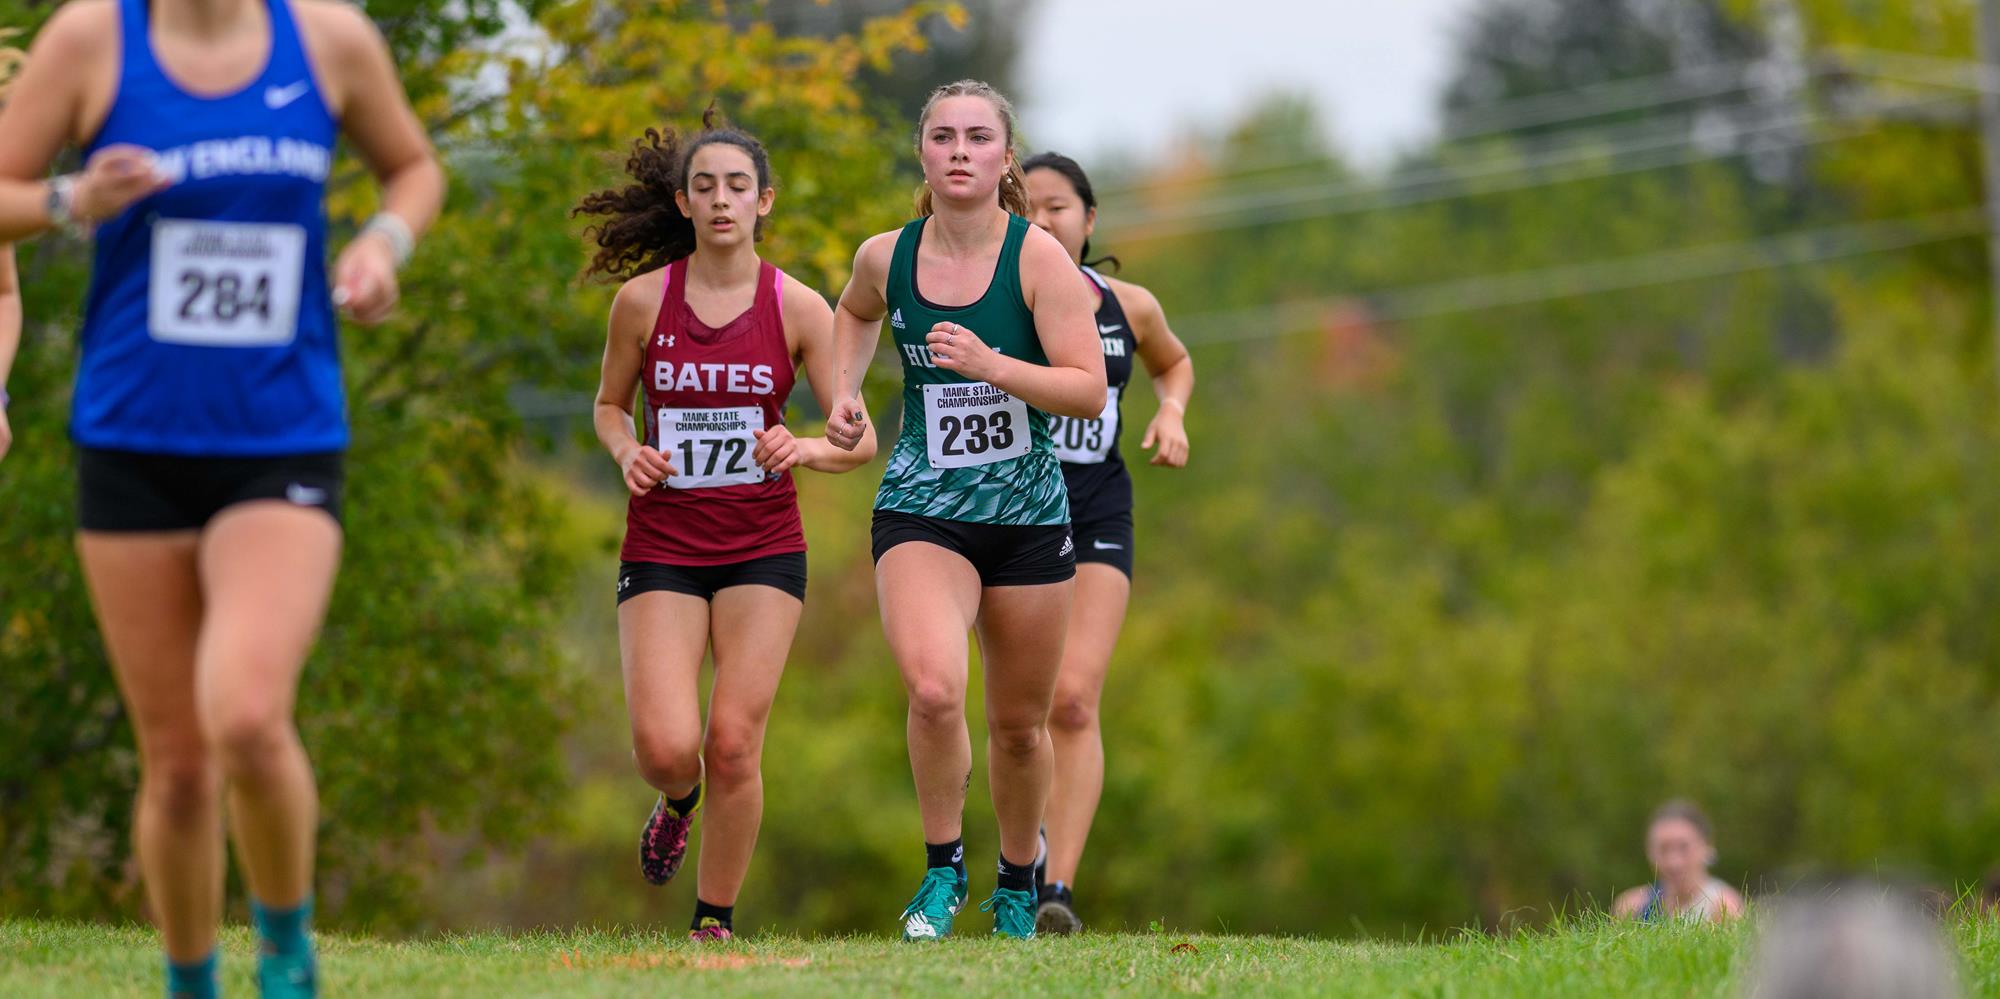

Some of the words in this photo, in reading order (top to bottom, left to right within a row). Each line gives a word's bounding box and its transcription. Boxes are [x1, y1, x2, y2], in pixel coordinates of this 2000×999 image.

[178, 269, 270, 324] 284
[655, 361, 774, 395] BATES
[943, 387, 970, 398] MAINE
[682, 412, 709, 422] MAINE
[712, 411, 740, 421] STATE
[937, 393, 1009, 409] CHAMPIONSHIPS
[676, 421, 747, 432] CHAMPIONSHIPS
[939, 411, 1014, 456] 233
[1048, 416, 1104, 451] 203
[677, 438, 748, 477] 172
